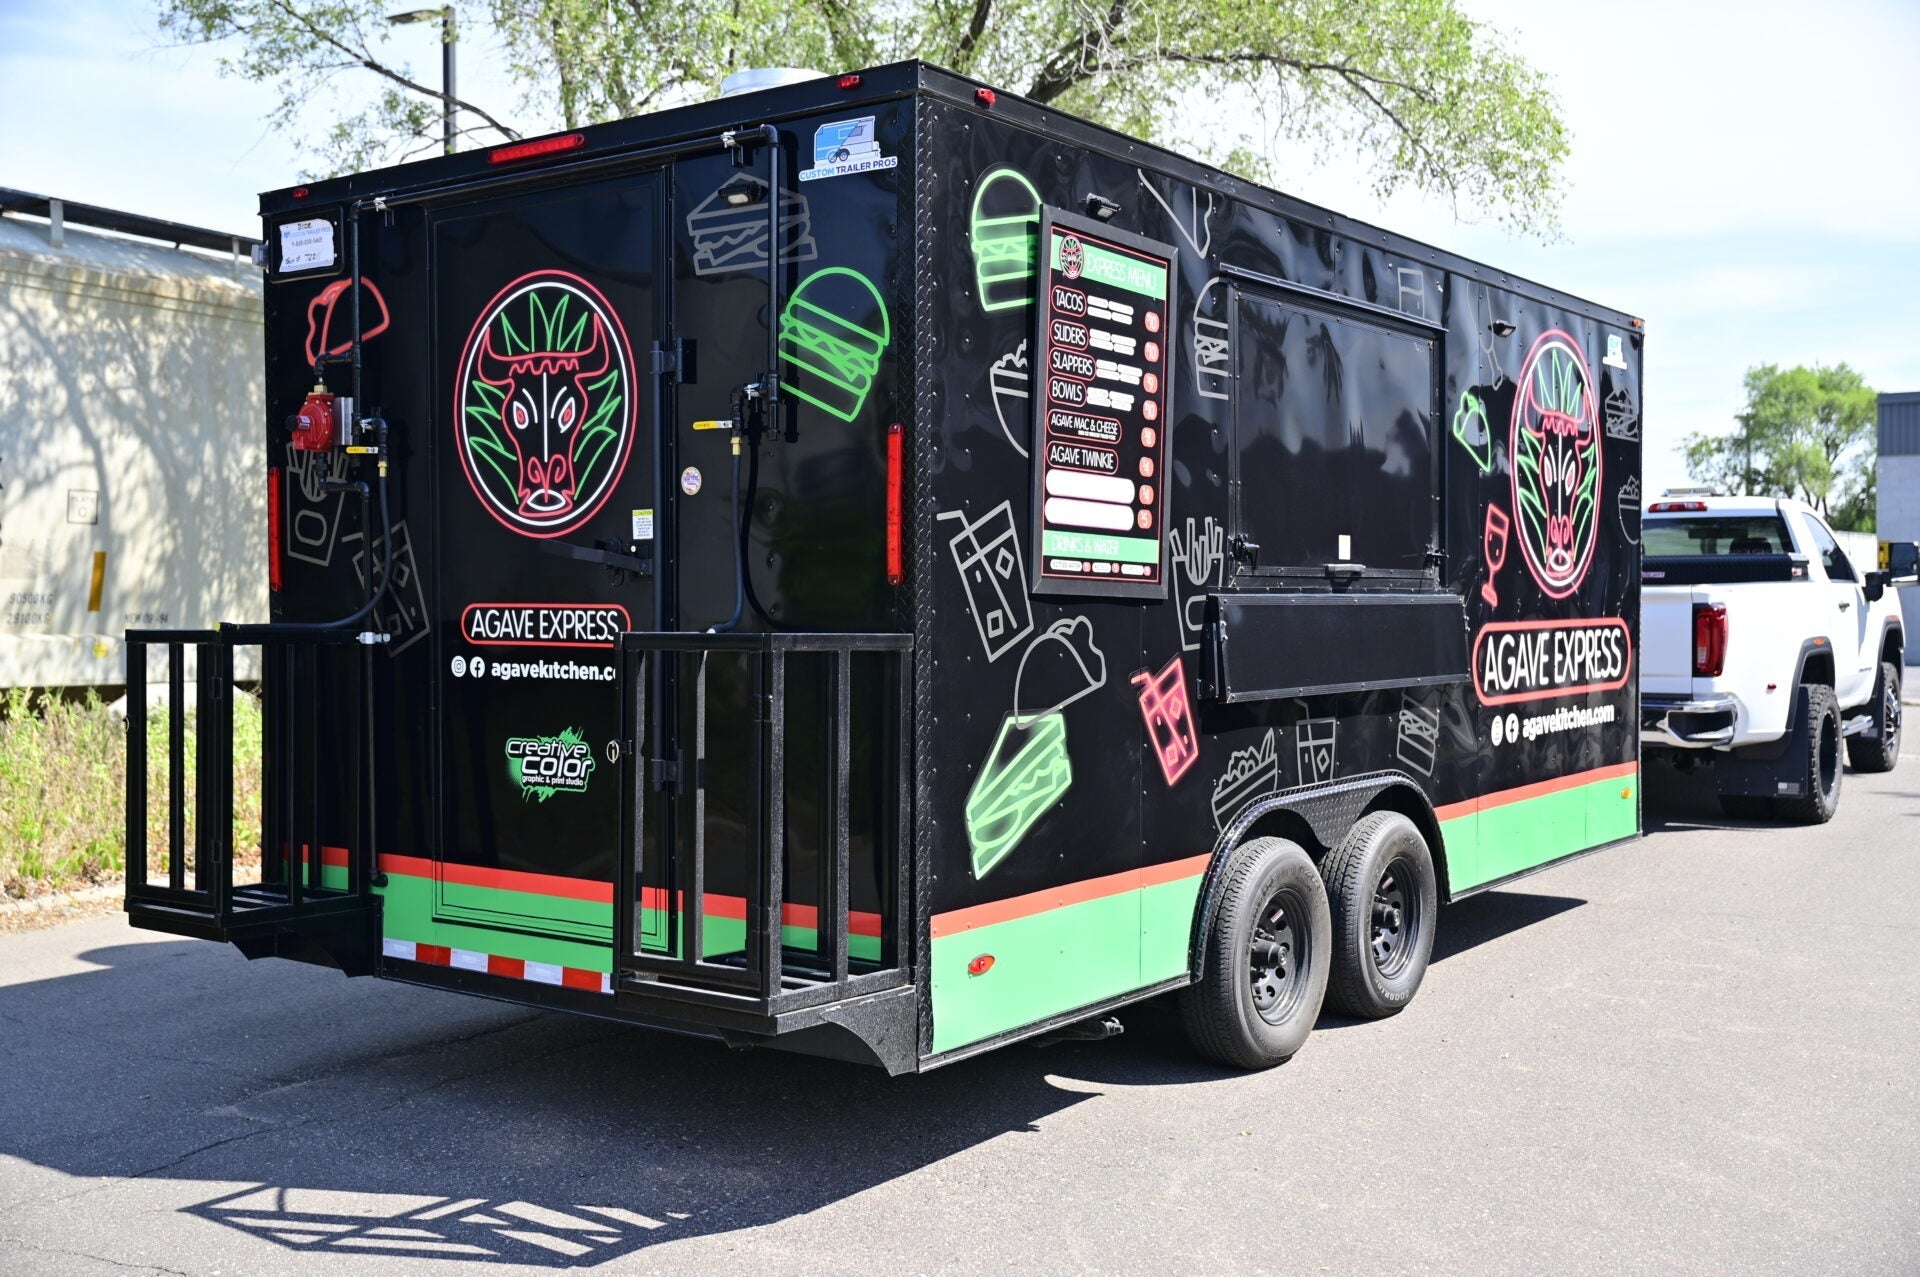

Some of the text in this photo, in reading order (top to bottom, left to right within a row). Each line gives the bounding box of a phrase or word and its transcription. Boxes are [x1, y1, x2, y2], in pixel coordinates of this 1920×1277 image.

[800, 158, 897, 180] CUSTOM TRAILER PROS
[1086, 253, 1156, 291] EXPRESS MENU
[1055, 289, 1084, 313] TACOS
[1053, 323, 1086, 346] SLIDERS
[1052, 352, 1093, 376] SLAPPERS
[1052, 382, 1083, 402] BOWLS
[1051, 413, 1073, 429] AGAVE
[1073, 416, 1090, 431] MAC
[1090, 418, 1096, 431] &
[1096, 420, 1118, 436] CHEESE
[1050, 445, 1114, 470] AGAVE TWINKIE
[1051, 534, 1120, 555] DRINKS & WATER
[471, 609, 619, 641] AGAVE EXPRESS
[491, 660, 616, 681] agavekitchen.c
[1483, 628, 1622, 692] AGAVE EXPRESS
[1522, 704, 1615, 741] agavekitchen.com
[508, 740, 587, 758] creative
[521, 751, 592, 777] color
[522, 775, 544, 783] graphic
[551, 777, 565, 785] print
[566, 777, 584, 786] studio
